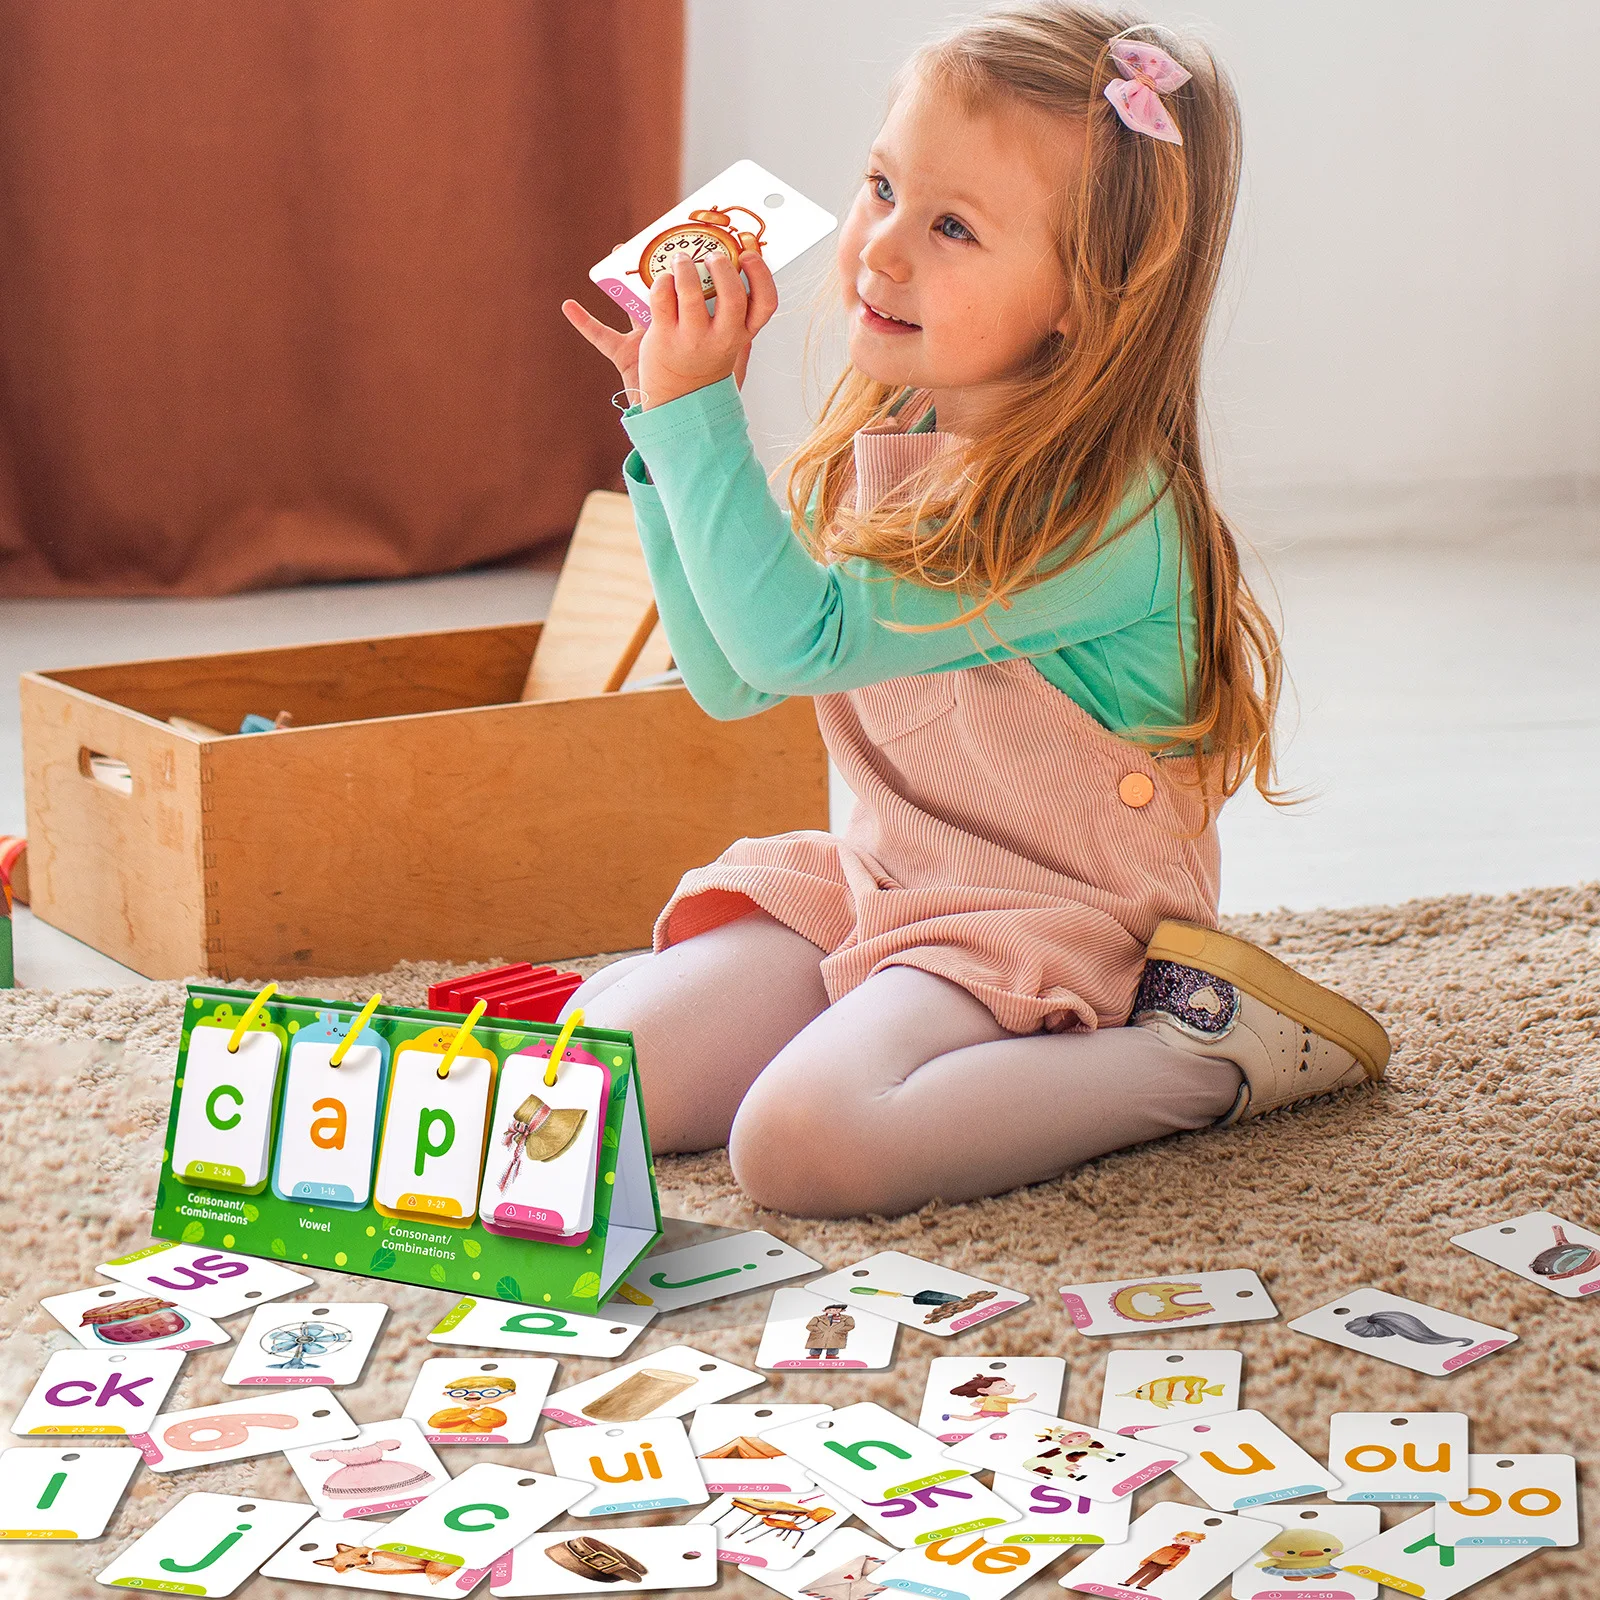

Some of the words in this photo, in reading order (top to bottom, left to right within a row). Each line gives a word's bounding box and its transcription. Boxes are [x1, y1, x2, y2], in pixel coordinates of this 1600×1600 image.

[664, 242, 675, 252] 9
[676, 239, 690, 249] 10
[705, 241, 718, 251] 12
[656, 254, 667, 263] 8
[656, 265, 666, 273] 7
[625, 299, 652, 323] 23-50
[205, 1084, 244, 1131] c
[310, 1097, 347, 1151] a
[414, 1107, 456, 1177] p
[213, 1167, 231, 1177] 2-34
[320, 1186, 336, 1195] 1-16
[187, 1192, 246, 1211] Consonant/
[427, 1199, 446, 1209] 9-29
[180, 1205, 249, 1226] Combinations
[299, 1217, 331, 1233] Vowel
[528, 1210, 547, 1221] 1-50
[389, 1226, 452, 1245] Consonant/
[381, 1239, 456, 1261] Combinations
[45, 1372, 154, 1407] ck
[588, 1442, 663, 1484] ui
[1199, 1443, 1276, 1476] u
[1344, 1442, 1451, 1473] ou
[631, 1500, 662, 1509] 16-16
[1449, 1487, 1562, 1517] oo
[444, 1503, 510, 1532] c
[159, 1524, 253, 1573] j
